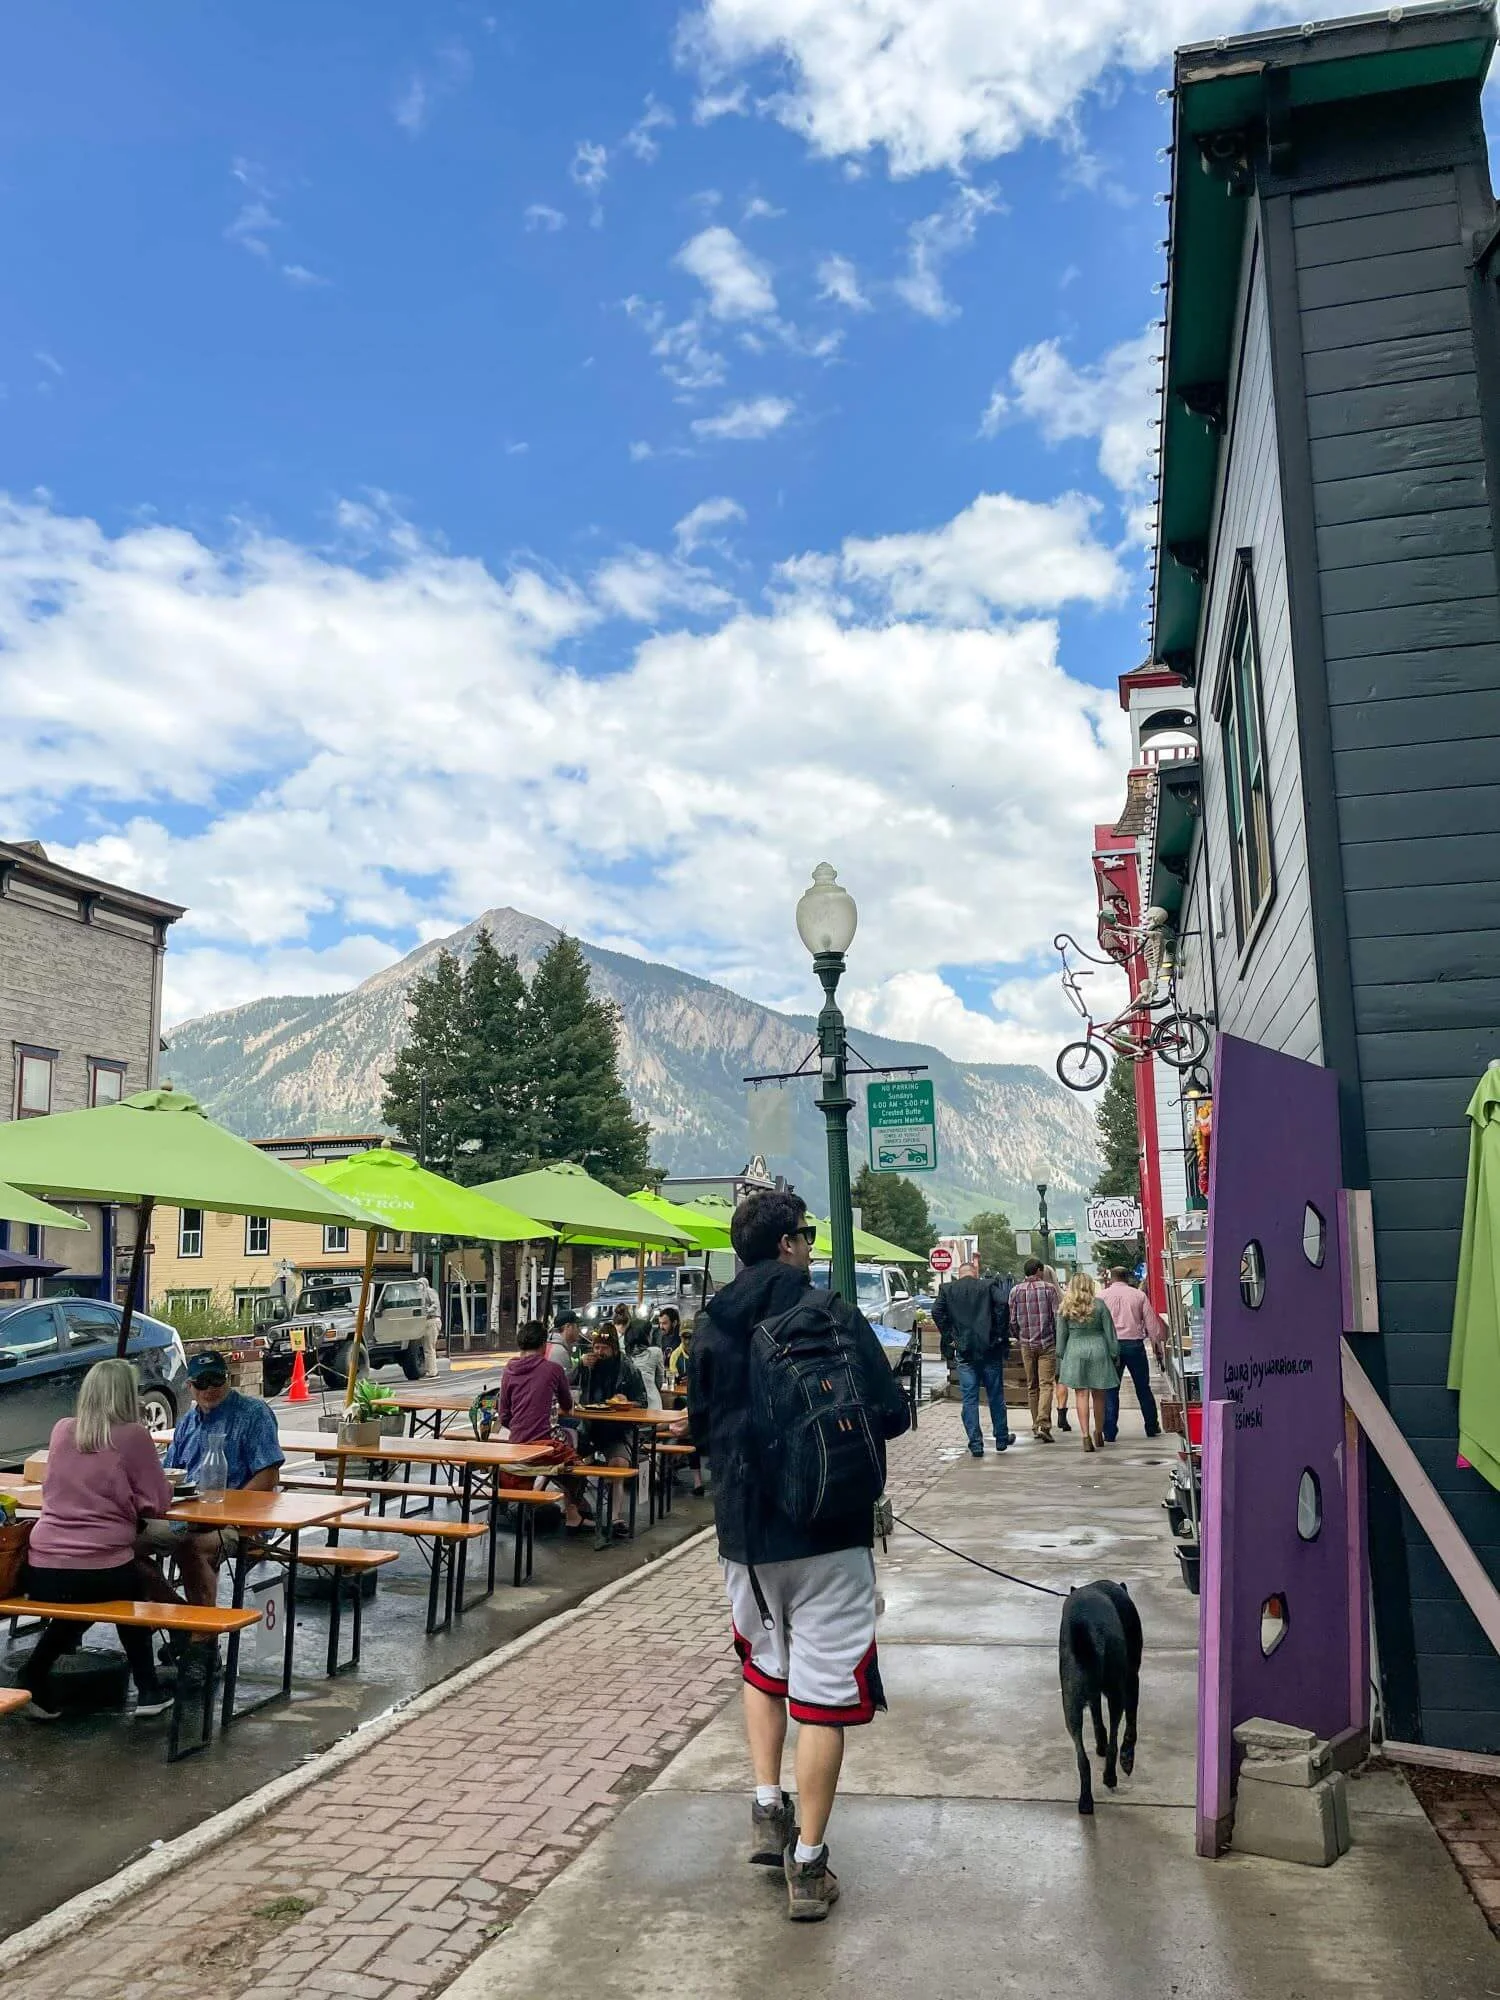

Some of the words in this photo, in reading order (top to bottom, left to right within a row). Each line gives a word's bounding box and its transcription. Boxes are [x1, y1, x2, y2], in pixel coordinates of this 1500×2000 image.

[892, 1083, 919, 1091] PARKING
[889, 1100, 898, 1108] AM
[881, 1109, 904, 1117] Crested
[879, 1117, 903, 1125] Farmers
[904, 1116, 925, 1124] Market
[1093, 1208, 1135, 1219] PARAGON
[1094, 1218, 1134, 1228] GALLERY
[265, 1599, 276, 1631] 8
